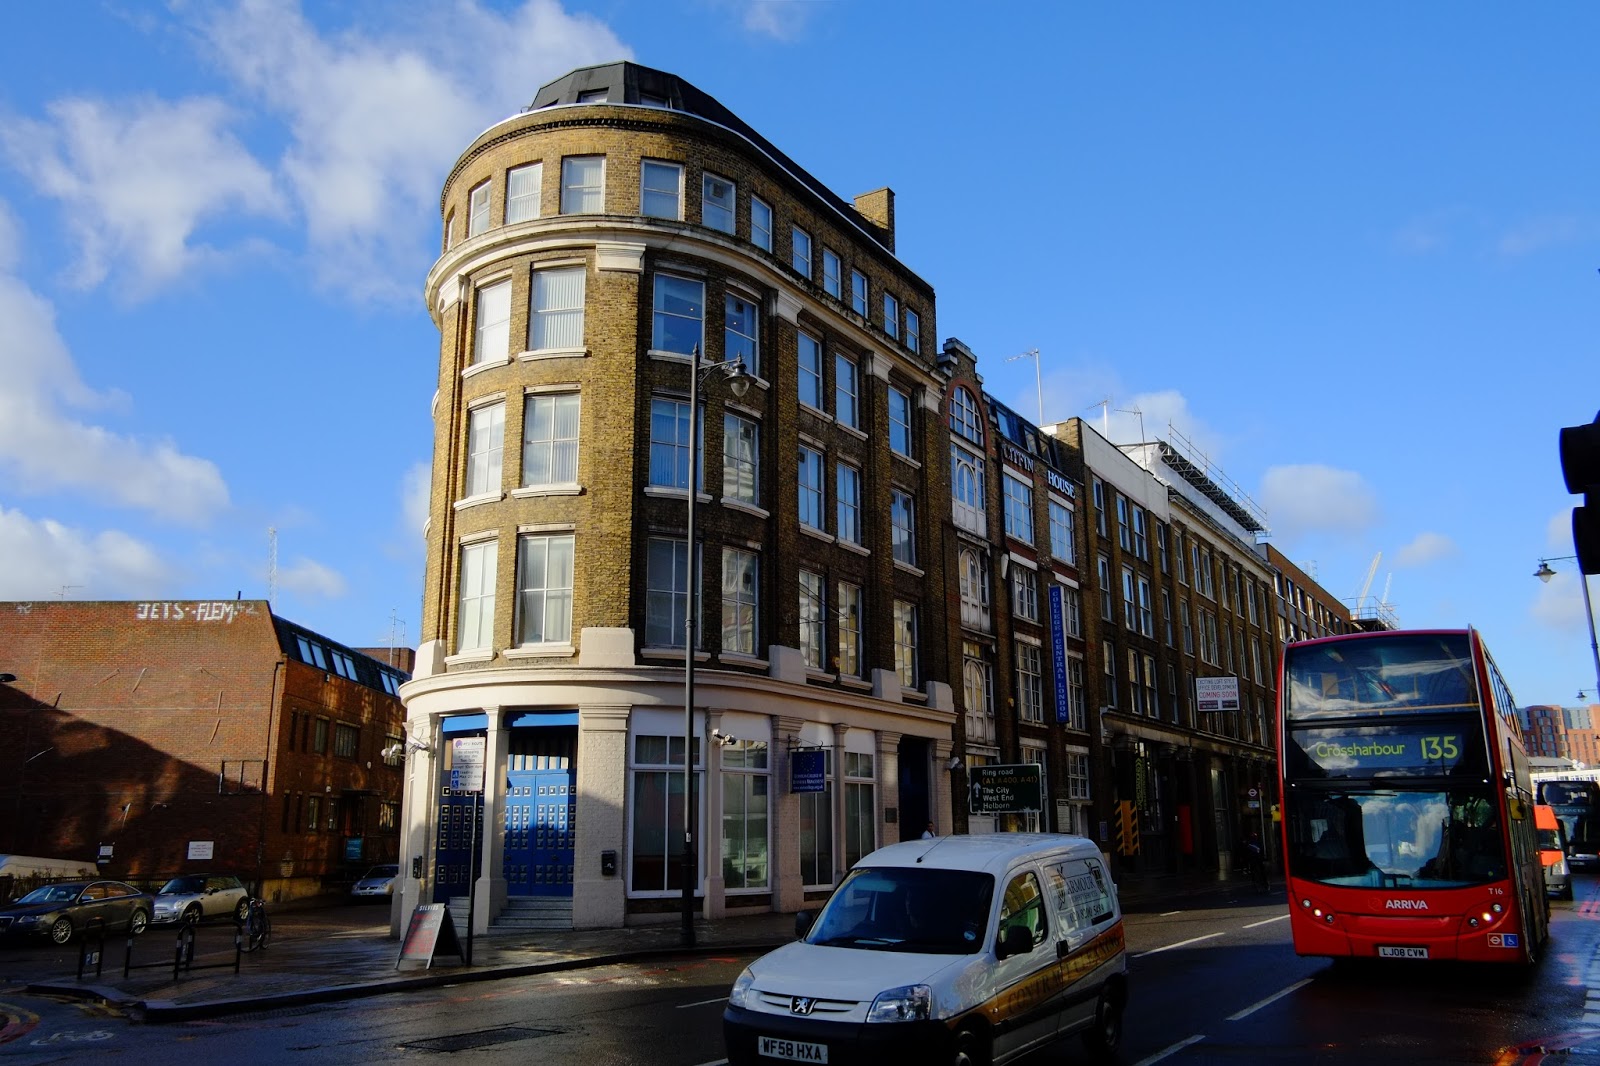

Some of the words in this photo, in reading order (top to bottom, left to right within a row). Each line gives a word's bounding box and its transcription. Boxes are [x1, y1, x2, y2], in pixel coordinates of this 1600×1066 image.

[1047, 470, 1075, 499] HOUSE
[1052, 591, 1061, 631] COLLEGE
[1055, 639, 1064, 679] CENTRAL
[1058, 682, 1066, 717] LONDON
[1316, 742, 1405, 757] Crossharbour
[1420, 736, 1458, 759] 135
[982, 769, 996, 777] Ring
[996, 786, 1010, 794] City
[1067, 876, 1095, 894] ARMOUR
[1386, 900, 1428, 909] ARRIVA
[1382, 948, 1405, 956] LJ08
[1407, 949, 1425, 957] CVM
[763, 1038, 793, 1056] WF58
[797, 1043, 821, 1060] HXA
